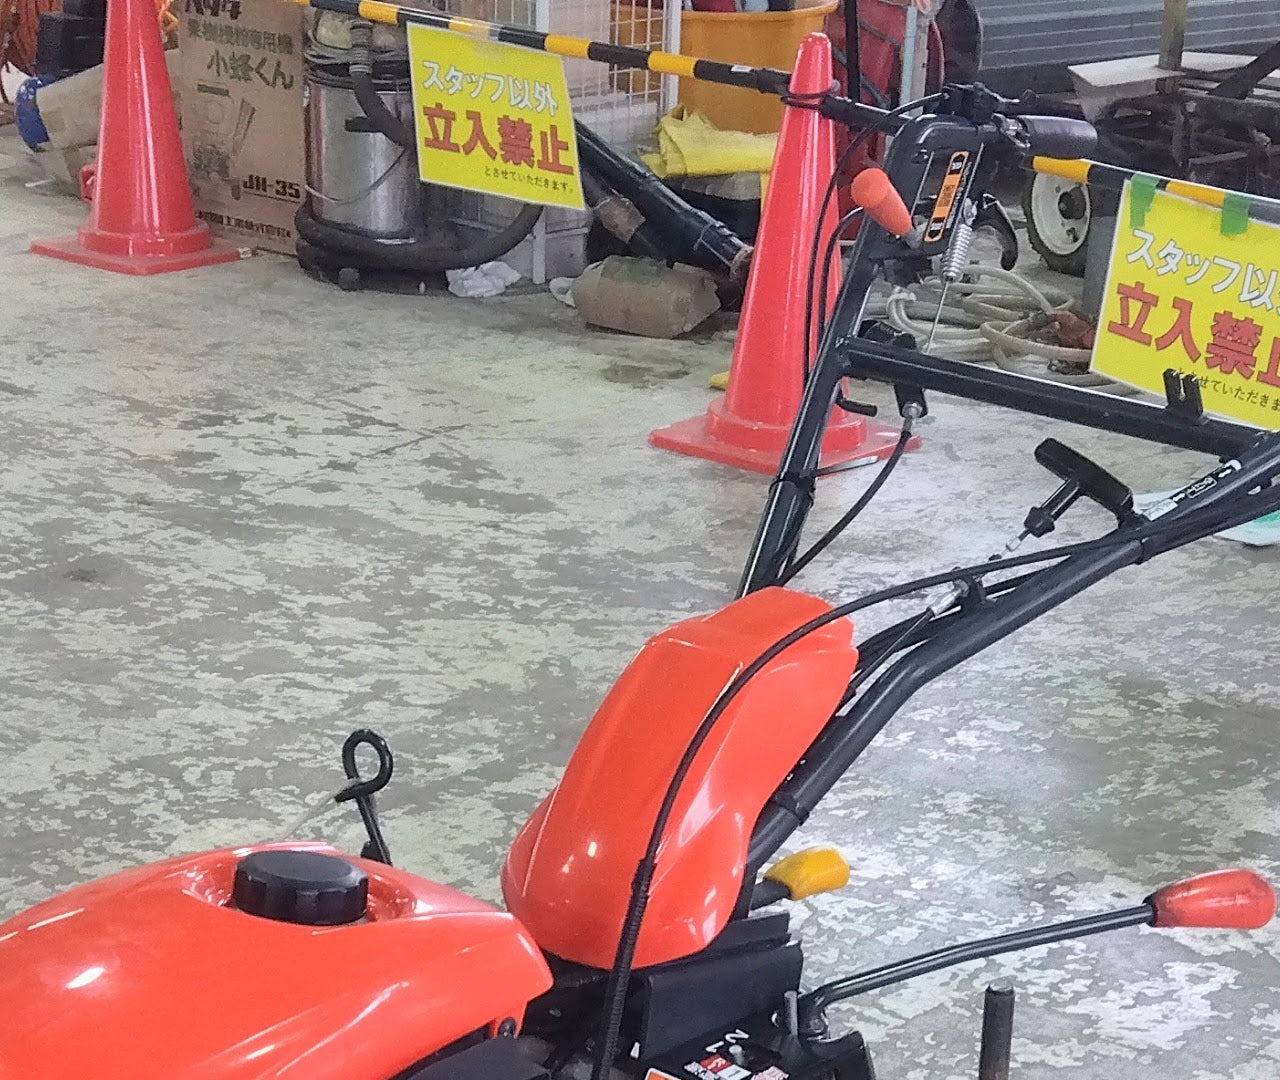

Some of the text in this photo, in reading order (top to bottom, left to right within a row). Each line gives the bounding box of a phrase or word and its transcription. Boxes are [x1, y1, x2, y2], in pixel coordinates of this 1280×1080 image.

[422, 60, 559, 117] スタッフ以外
[422, 102, 575, 176] 立入禁止
